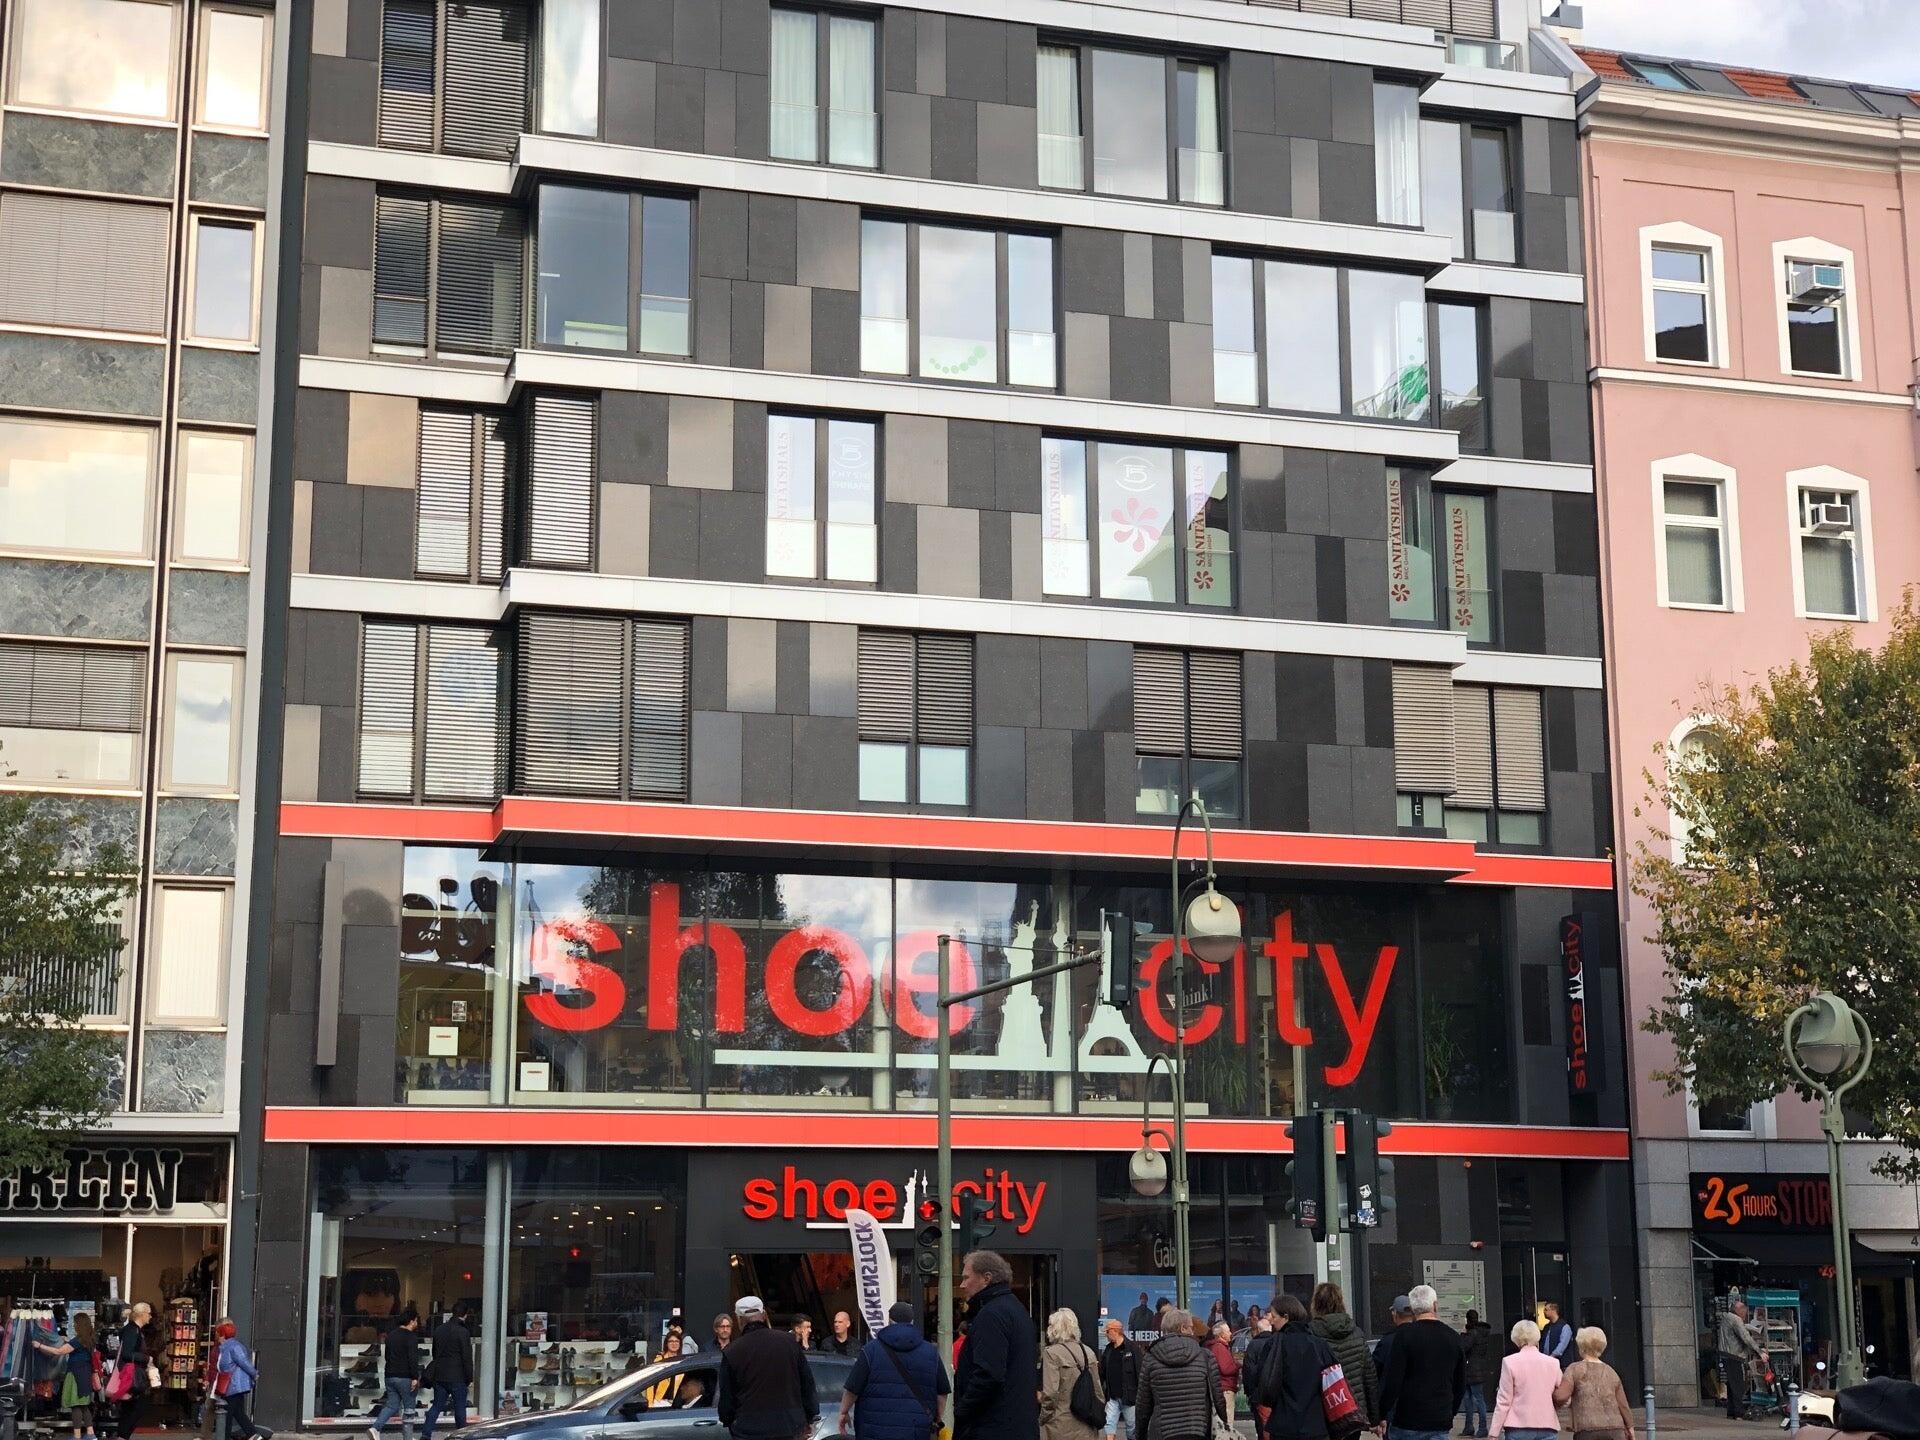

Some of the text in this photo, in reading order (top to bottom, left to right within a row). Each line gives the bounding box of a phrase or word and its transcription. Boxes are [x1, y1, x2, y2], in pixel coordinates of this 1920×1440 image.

[775, 432, 789, 536] NITÄTSHAUS
[1049, 447, 1061, 568] NITÄTSHAUS
[1389, 479, 1403, 580] SANITÄTSHAUS
[1452, 507, 1466, 604] SANITÄTSHAUS
[524, 883, 1400, 1087] shoe city
[1566, 921, 1587, 1089] shoe city
[0, 1149, 184, 1211] RLIN
[743, 1165, 1047, 1234] shoe city
[1704, 1177, 1749, 1225] 25
[1742, 1195, 1778, 1217] HOURS
[1778, 1180, 1833, 1226] STOR
[1153, 1238, 1177, 1269] Gab
[1135, 1330, 1160, 1342] NEEDS
